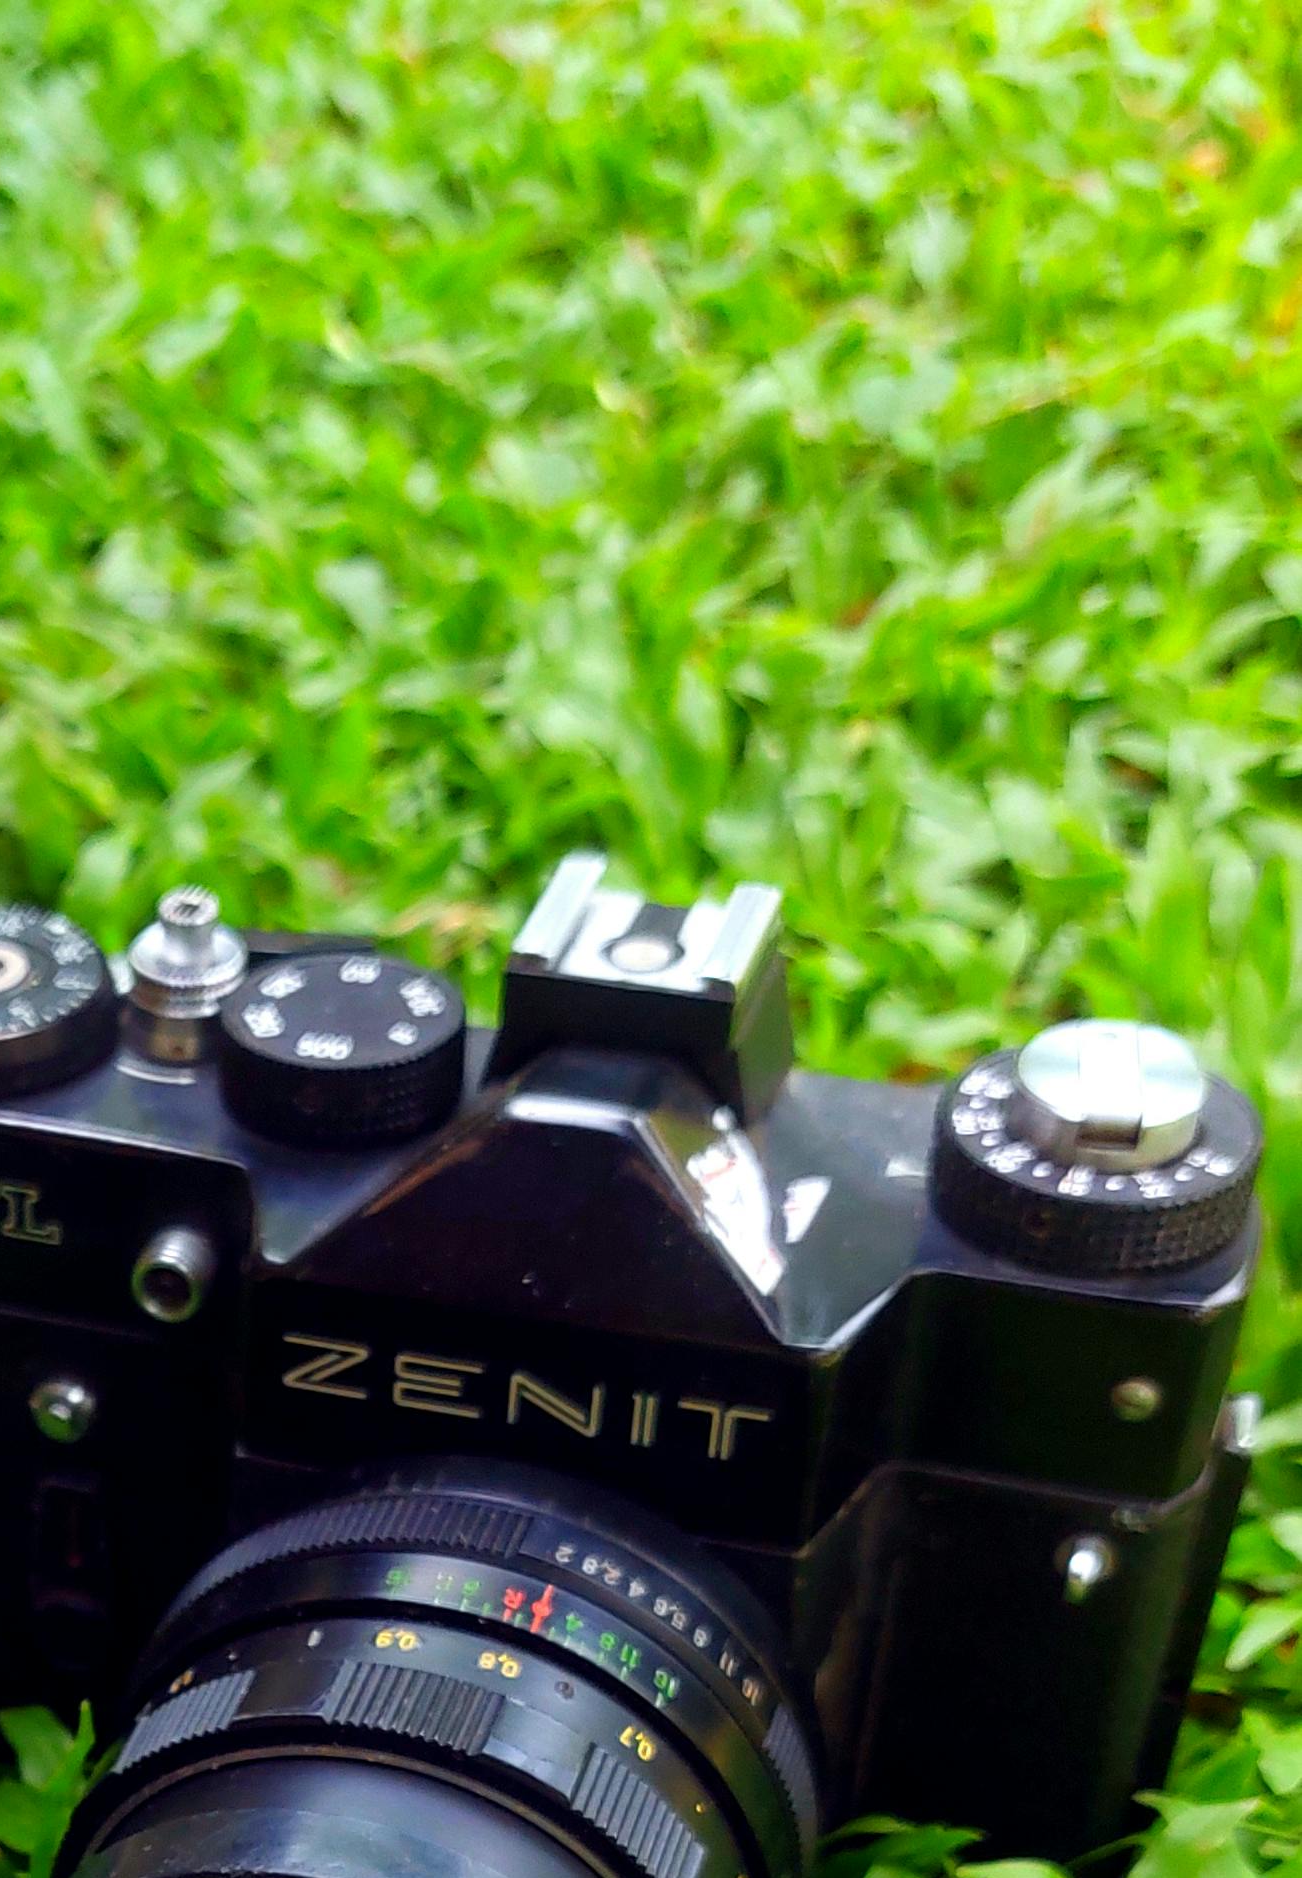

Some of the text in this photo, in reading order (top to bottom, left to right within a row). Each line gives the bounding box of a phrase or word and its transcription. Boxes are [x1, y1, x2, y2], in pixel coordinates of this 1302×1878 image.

[282, 1331, 775, 1462] ZENIT
[555, 1544, 574, 1564] 2
[503, 1586, 525, 1610] R
[627, 1577, 646, 1599] 4
